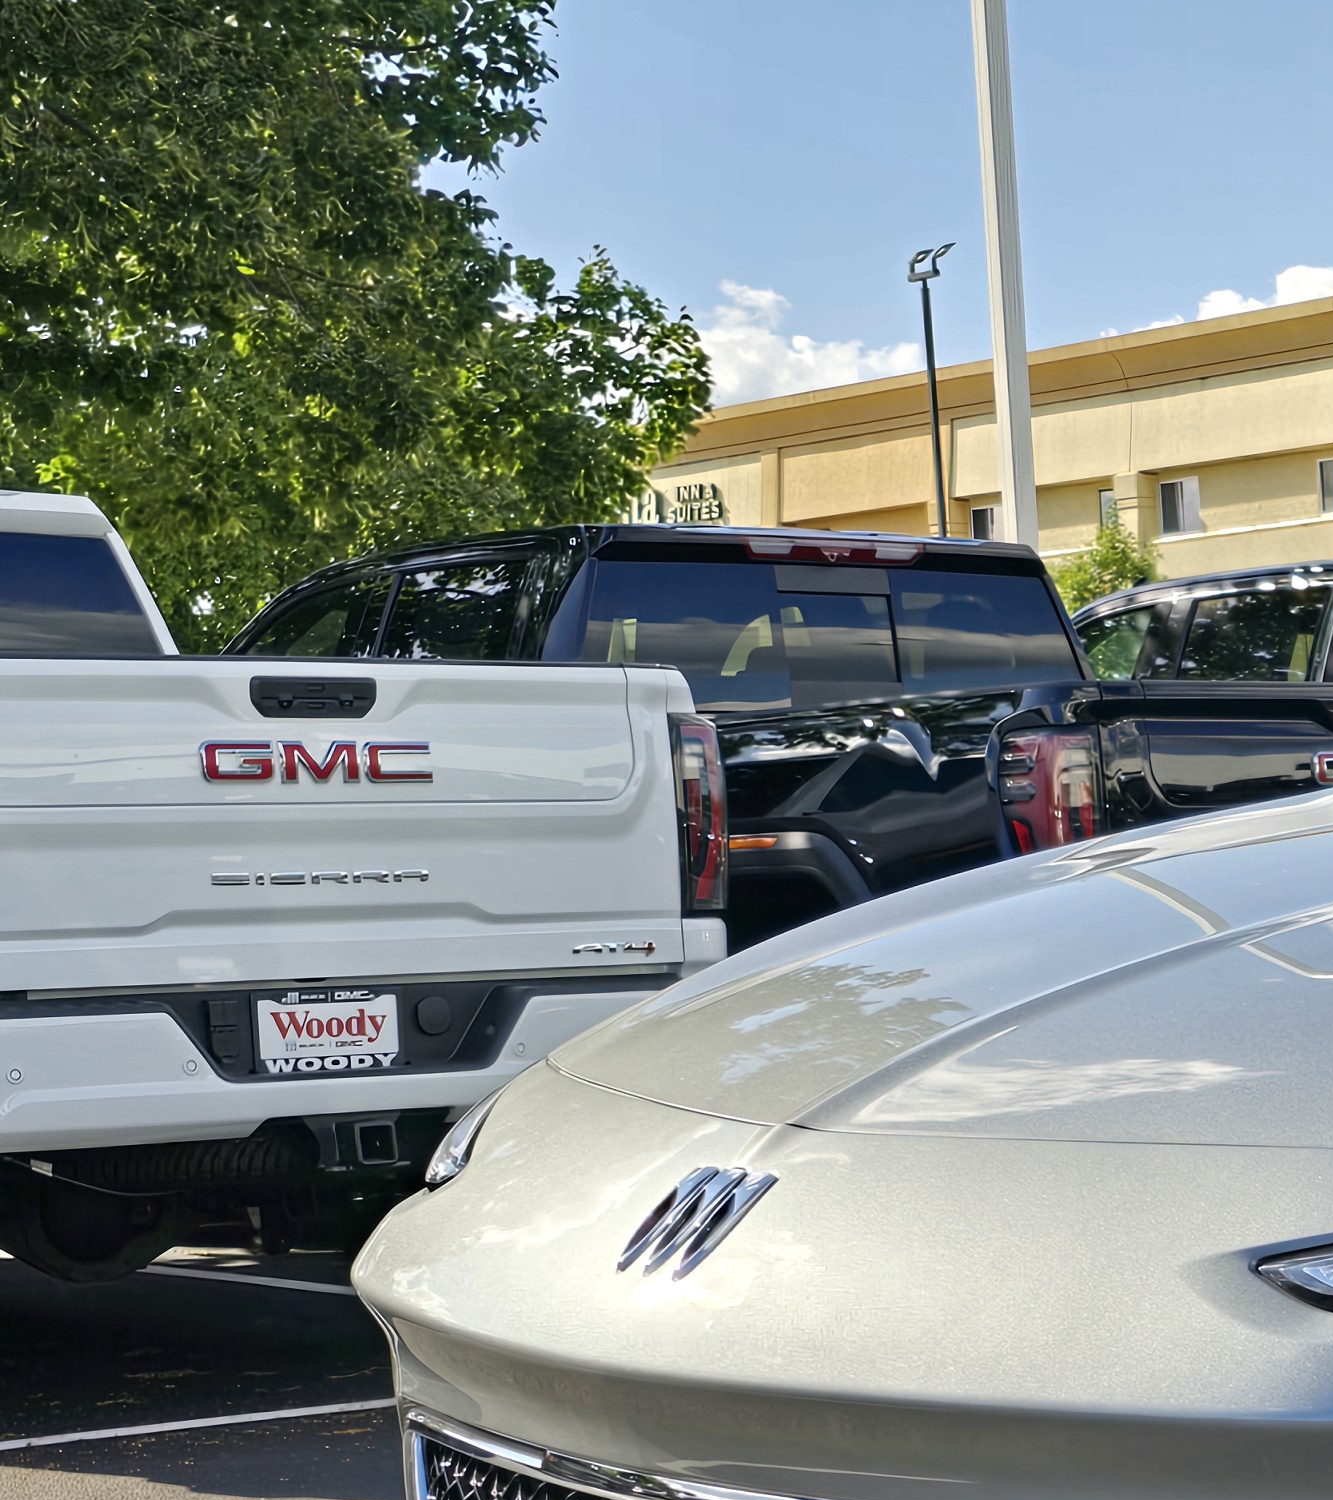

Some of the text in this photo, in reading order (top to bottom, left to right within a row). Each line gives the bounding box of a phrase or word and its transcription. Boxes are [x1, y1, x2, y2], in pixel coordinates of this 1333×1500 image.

[676, 484, 703, 502] INN
[666, 501, 722, 523] SUITES
[199, 739, 434, 785] GMC
[210, 869, 430, 886] SIERRA
[572, 940, 656, 957] AT4
[269, 1008, 388, 1043] Woody
[265, 1053, 398, 1074] WOODY
